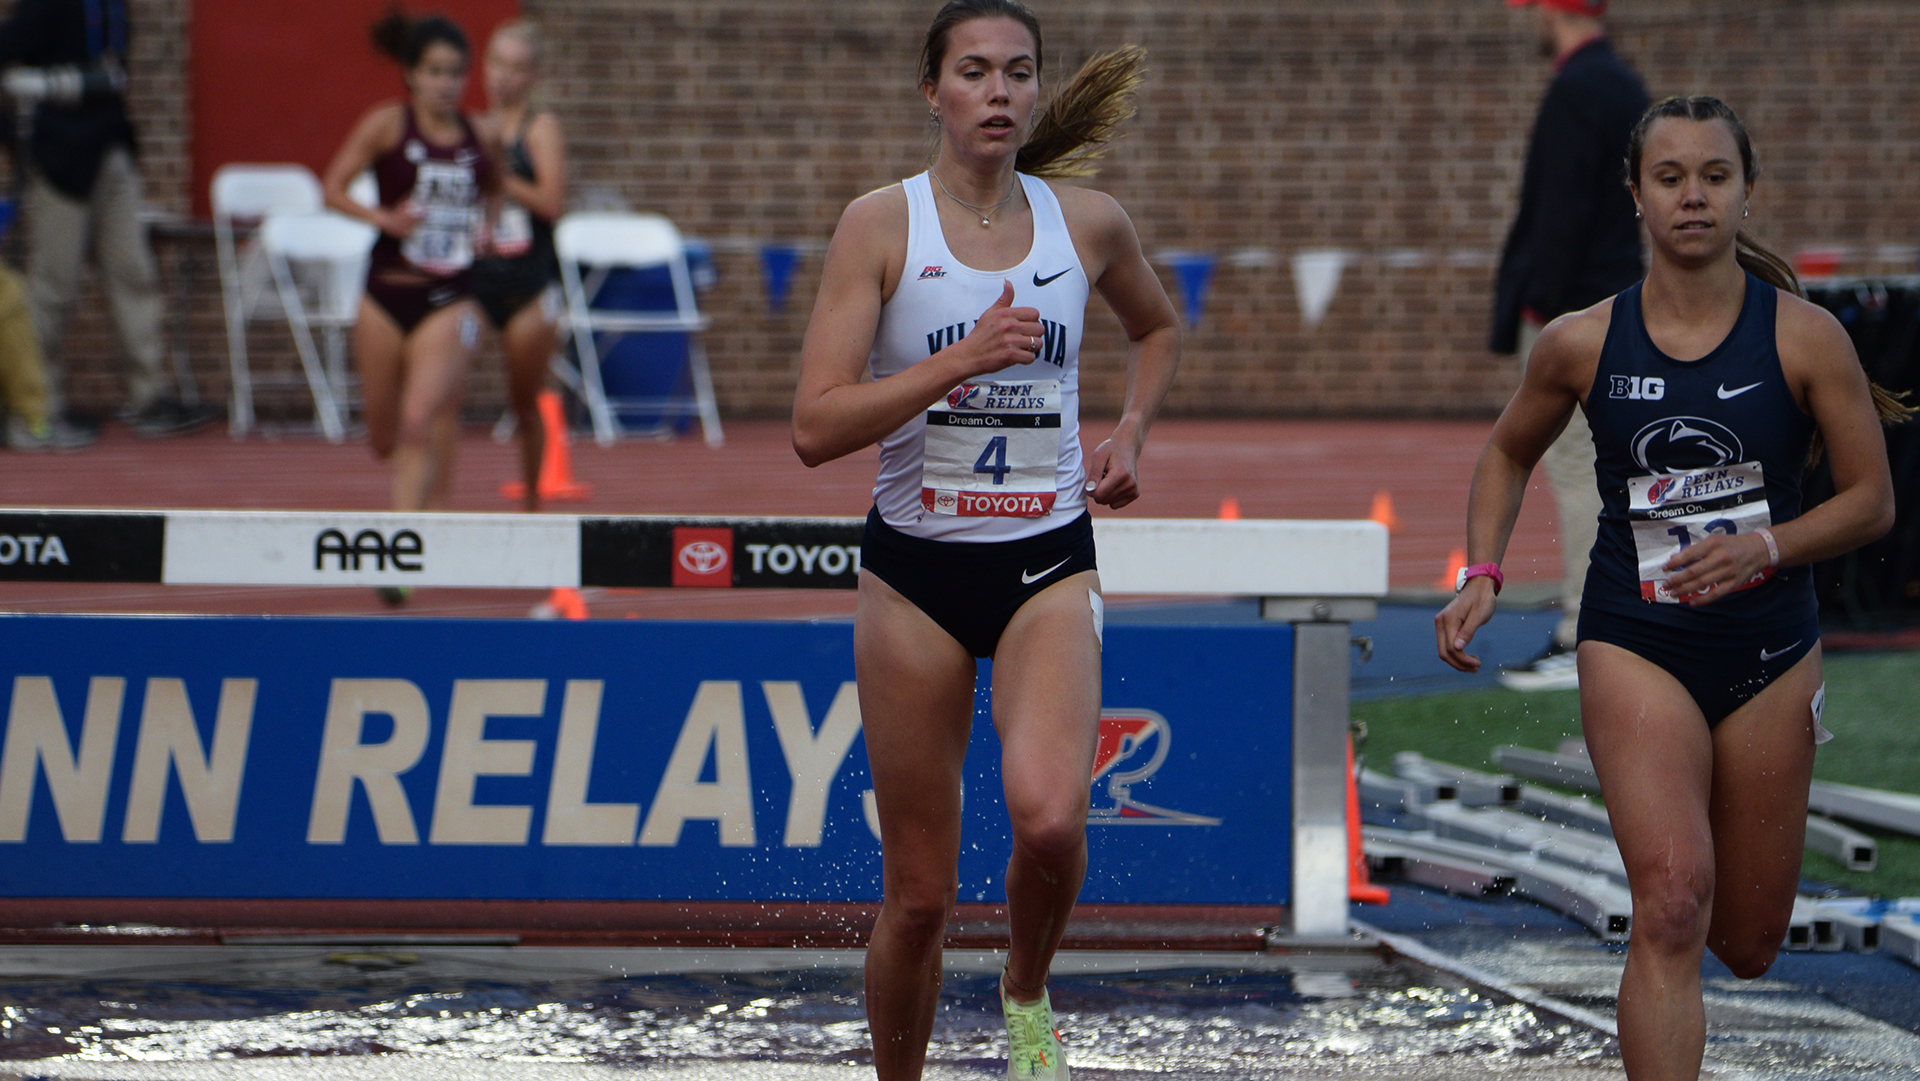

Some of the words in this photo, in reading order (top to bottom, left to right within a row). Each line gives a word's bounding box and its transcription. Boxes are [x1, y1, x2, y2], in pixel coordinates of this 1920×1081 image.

[988, 384, 1033, 397] PENN
[984, 397, 1045, 409] RELAYS
[948, 415, 983, 425] Dream
[984, 415, 1003, 426] On.
[973, 436, 1011, 485] 4
[1684, 469, 1729, 486] PENN
[1681, 476, 1745, 498] RELAYS
[963, 496, 1043, 512] TOYOTA
[1649, 506, 1685, 520] Dream
[1685, 504, 1706, 516] On.
[745, 544, 861, 575] TOYOT
